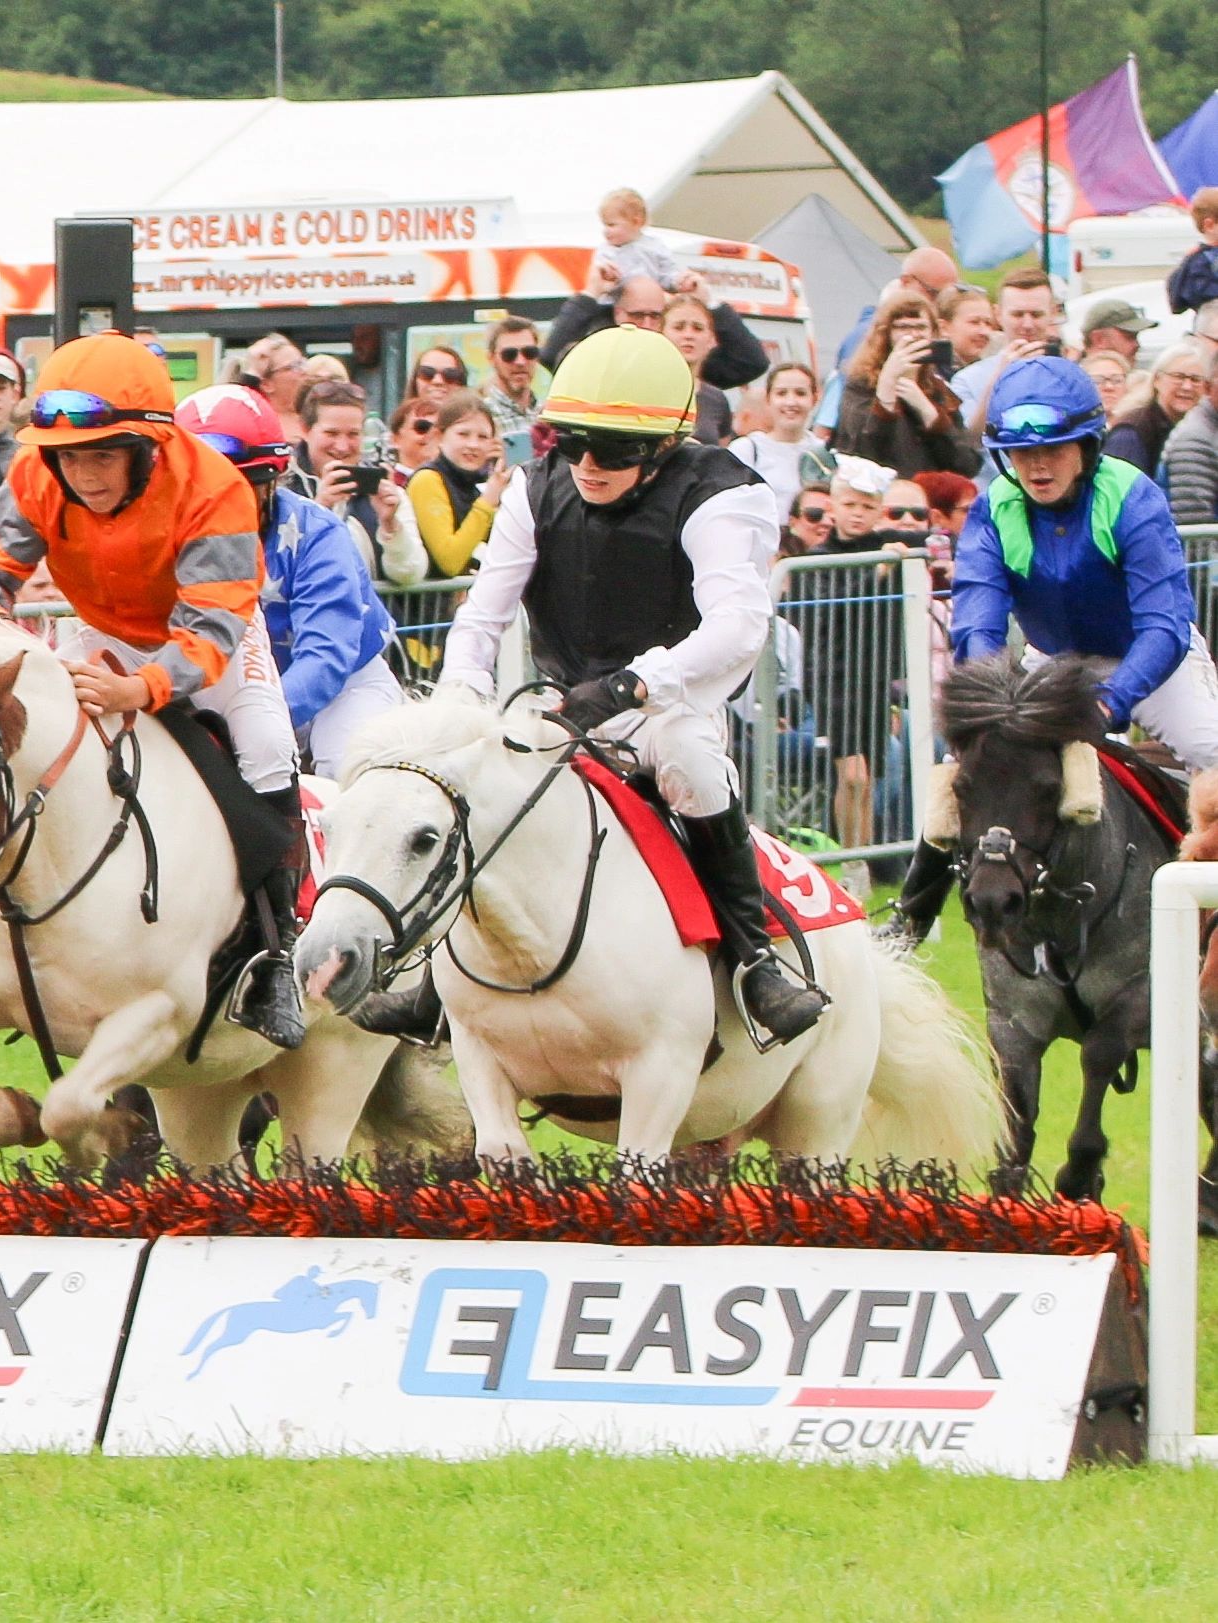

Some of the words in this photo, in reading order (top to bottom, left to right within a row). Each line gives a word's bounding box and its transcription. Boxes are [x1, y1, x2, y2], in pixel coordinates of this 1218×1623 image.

[133, 215, 161, 251] CE
[168, 212, 263, 249] CREAM
[269, 212, 287, 247] &
[295, 209, 369, 245] COLD
[377, 205, 476, 242] DRINKS
[553, 1281, 1020, 1380] EASYFIX
[788, 1418, 974, 1455] EQUINE
